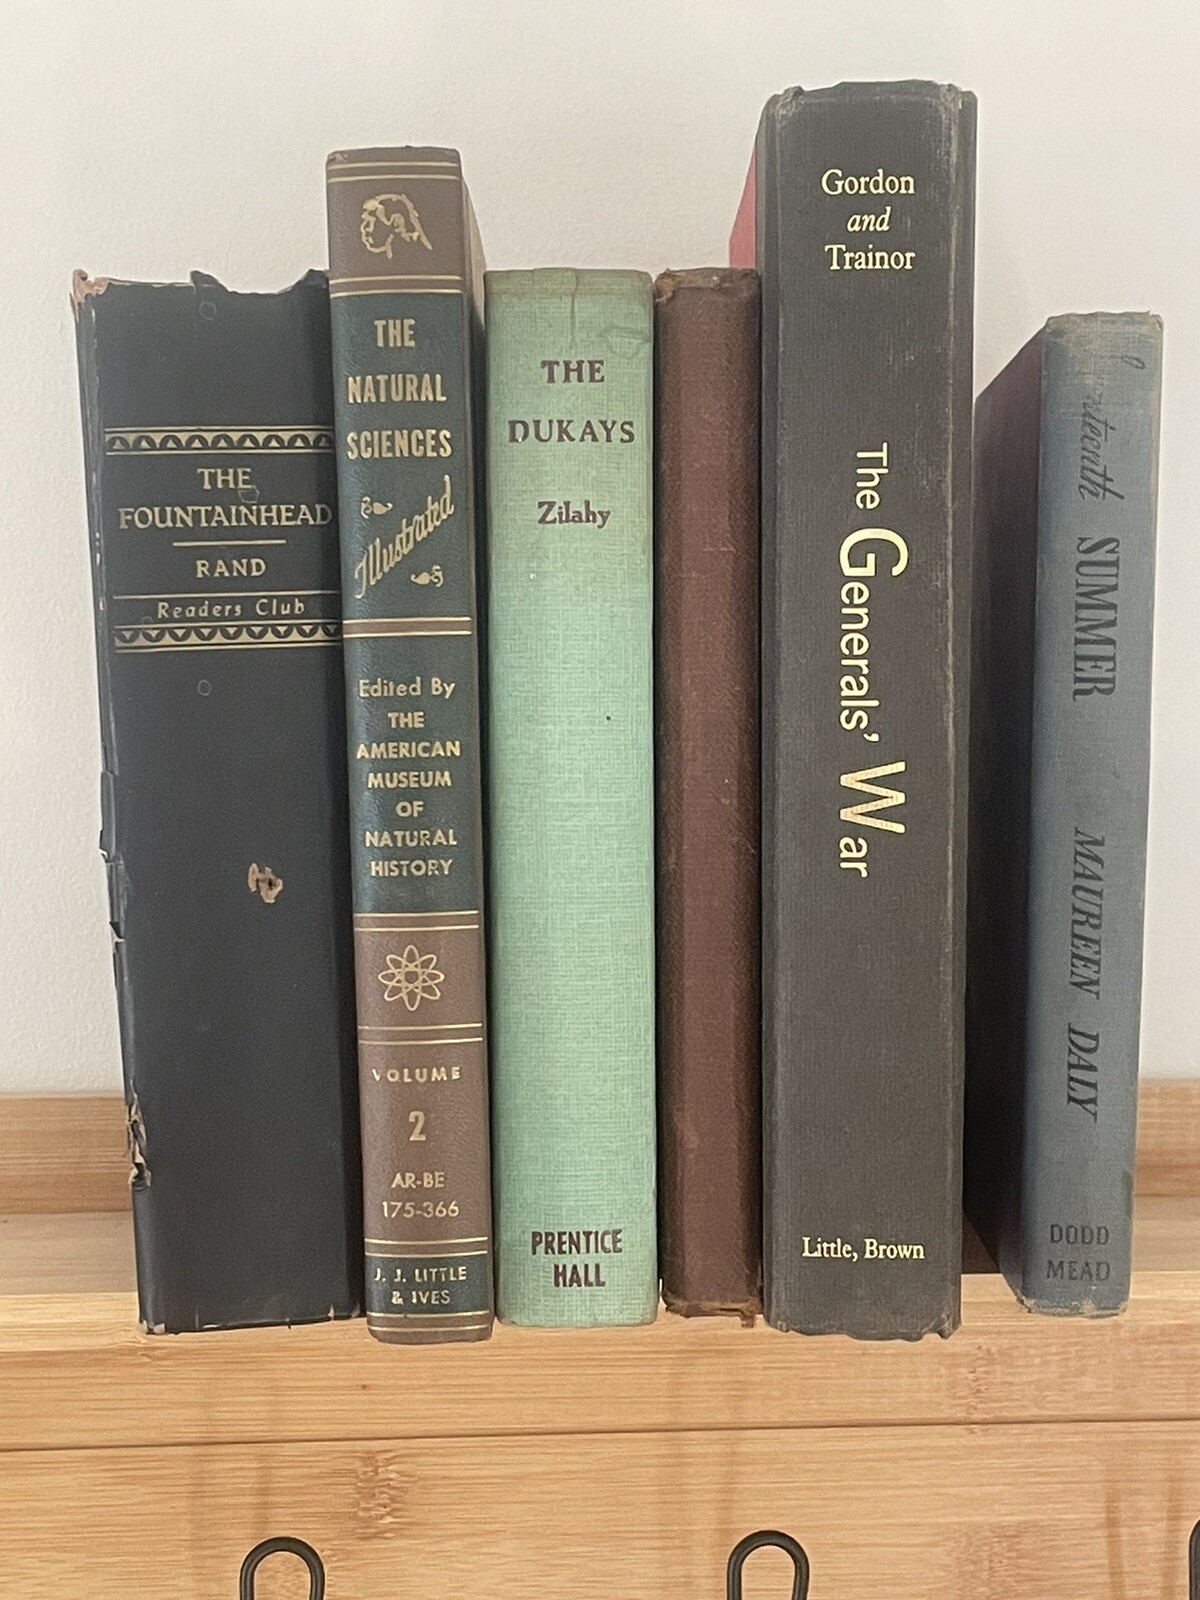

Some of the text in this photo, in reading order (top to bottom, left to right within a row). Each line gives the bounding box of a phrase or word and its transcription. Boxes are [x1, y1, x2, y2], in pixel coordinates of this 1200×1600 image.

[821, 168, 915, 195] Gordon
[846, 205, 892, 232] and
[824, 243, 916, 270] Trainor
[374, 318, 416, 347] THE
[540, 359, 606, 384] THE
[347, 373, 447, 403] NATURAL
[507, 419, 636, 444] DUKAYS
[346, 429, 453, 460] SCIENCES
[197, 468, 252, 490] THE
[118, 504, 332, 530] FOUNTAINHEAD
[537, 499, 611, 529] Zilahy
[354, 474, 454, 599] Illustrated
[195, 558, 267, 578] RAND
[157, 598, 305, 619] Readers Club
[1073, 536, 1121, 702] SUMMER
[838, 442, 909, 878] The Generals' War
[358, 676, 456, 699] Edited By
[387, 711, 425, 729] THE
[356, 741, 461, 760] AMERICAN
[367, 771, 452, 789] MUSEUM
[395, 801, 424, 817] OF
[364, 829, 457, 848] NATURAL
[370, 859, 453, 877] HISTORY
[1067, 827, 1106, 1000] MAUREEN
[371, 1066, 461, 1083] VOLUME
[1066, 1022, 1100, 1124] DALY
[408, 1111, 427, 1142] 2
[391, 1172, 445, 1189] AR-BE
[381, 1201, 460, 1219] 175-366
[531, 1229, 623, 1255] PRENTICE
[1049, 1223, 1109, 1245] DODD
[801, 1236, 926, 1263] Little, Brown
[374, 1266, 467, 1283] J. J. LITTLE
[553, 1263, 606, 1288] HALL
[1046, 1258, 1110, 1281] MEAD
[391, 1290, 451, 1305] & IVES
